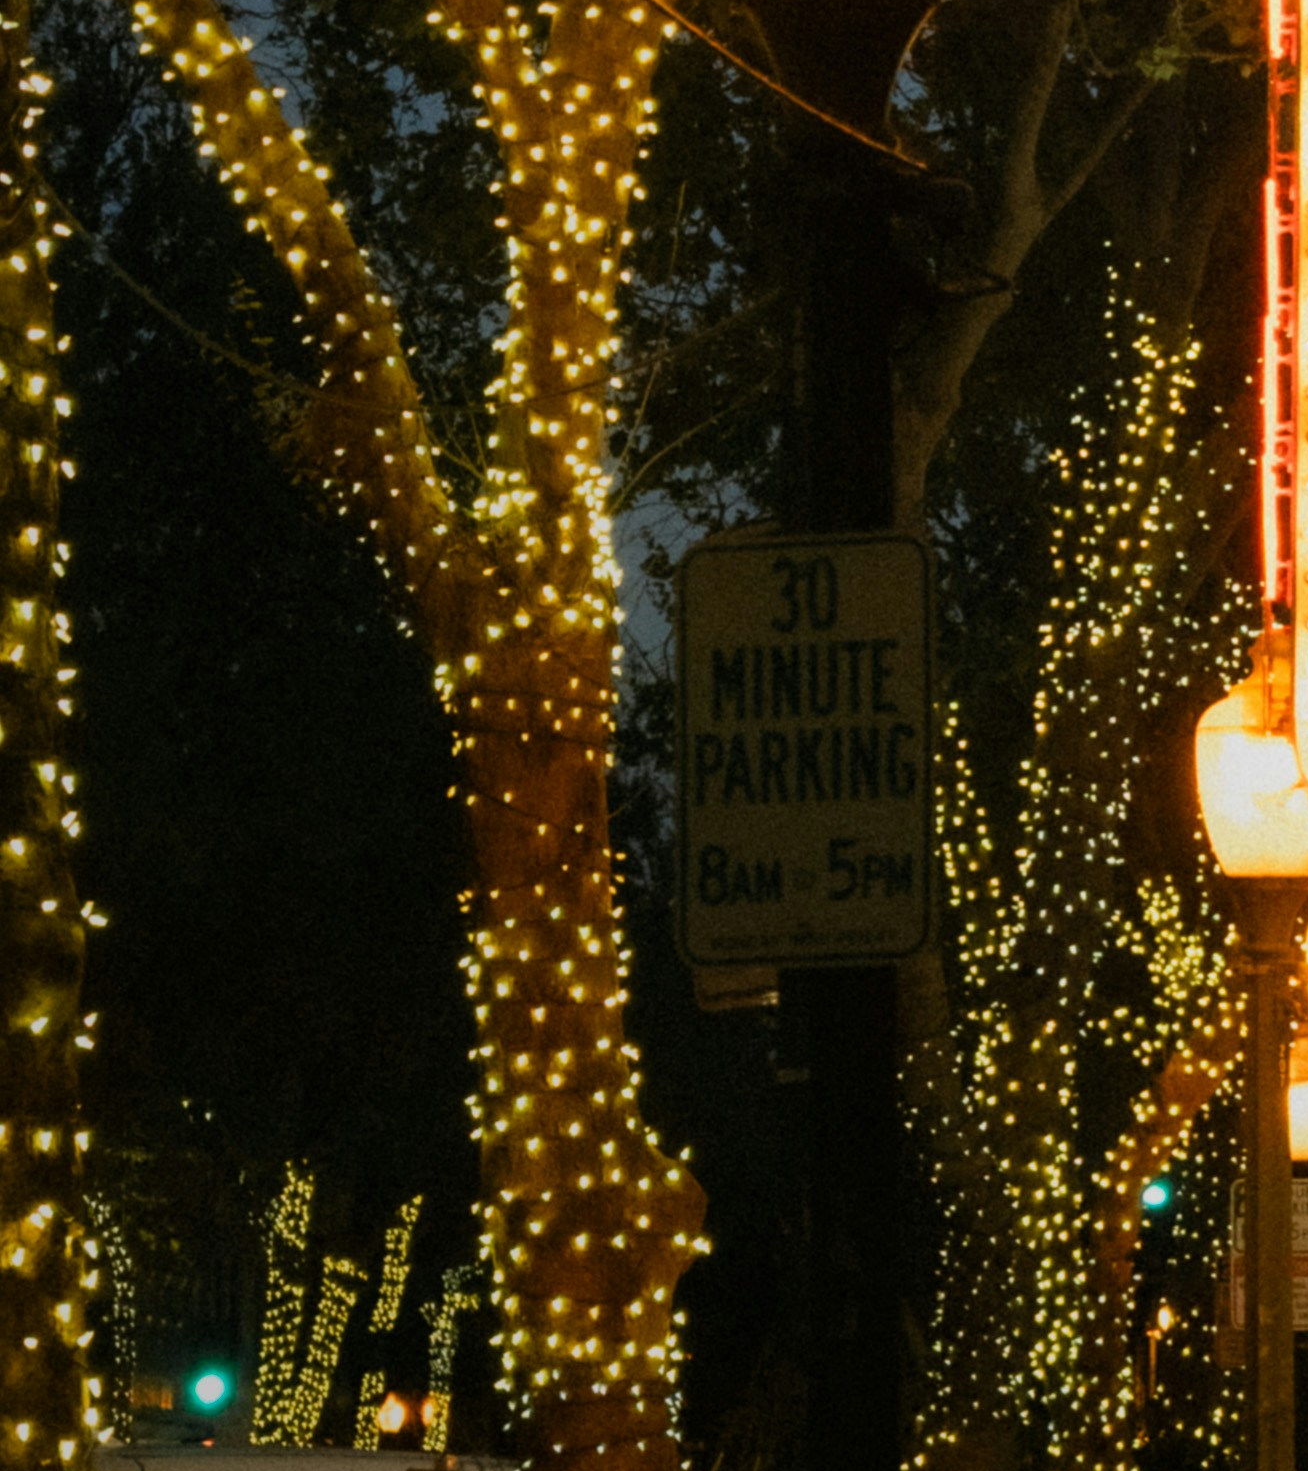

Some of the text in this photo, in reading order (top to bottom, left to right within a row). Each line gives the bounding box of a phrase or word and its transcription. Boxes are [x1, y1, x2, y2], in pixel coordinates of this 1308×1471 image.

[771, 556, 839, 632] 30
[712, 639, 898, 721] MINUTE
[695, 724, 916, 807] PARKING
[698, 839, 913, 905] 8AM 5PM
